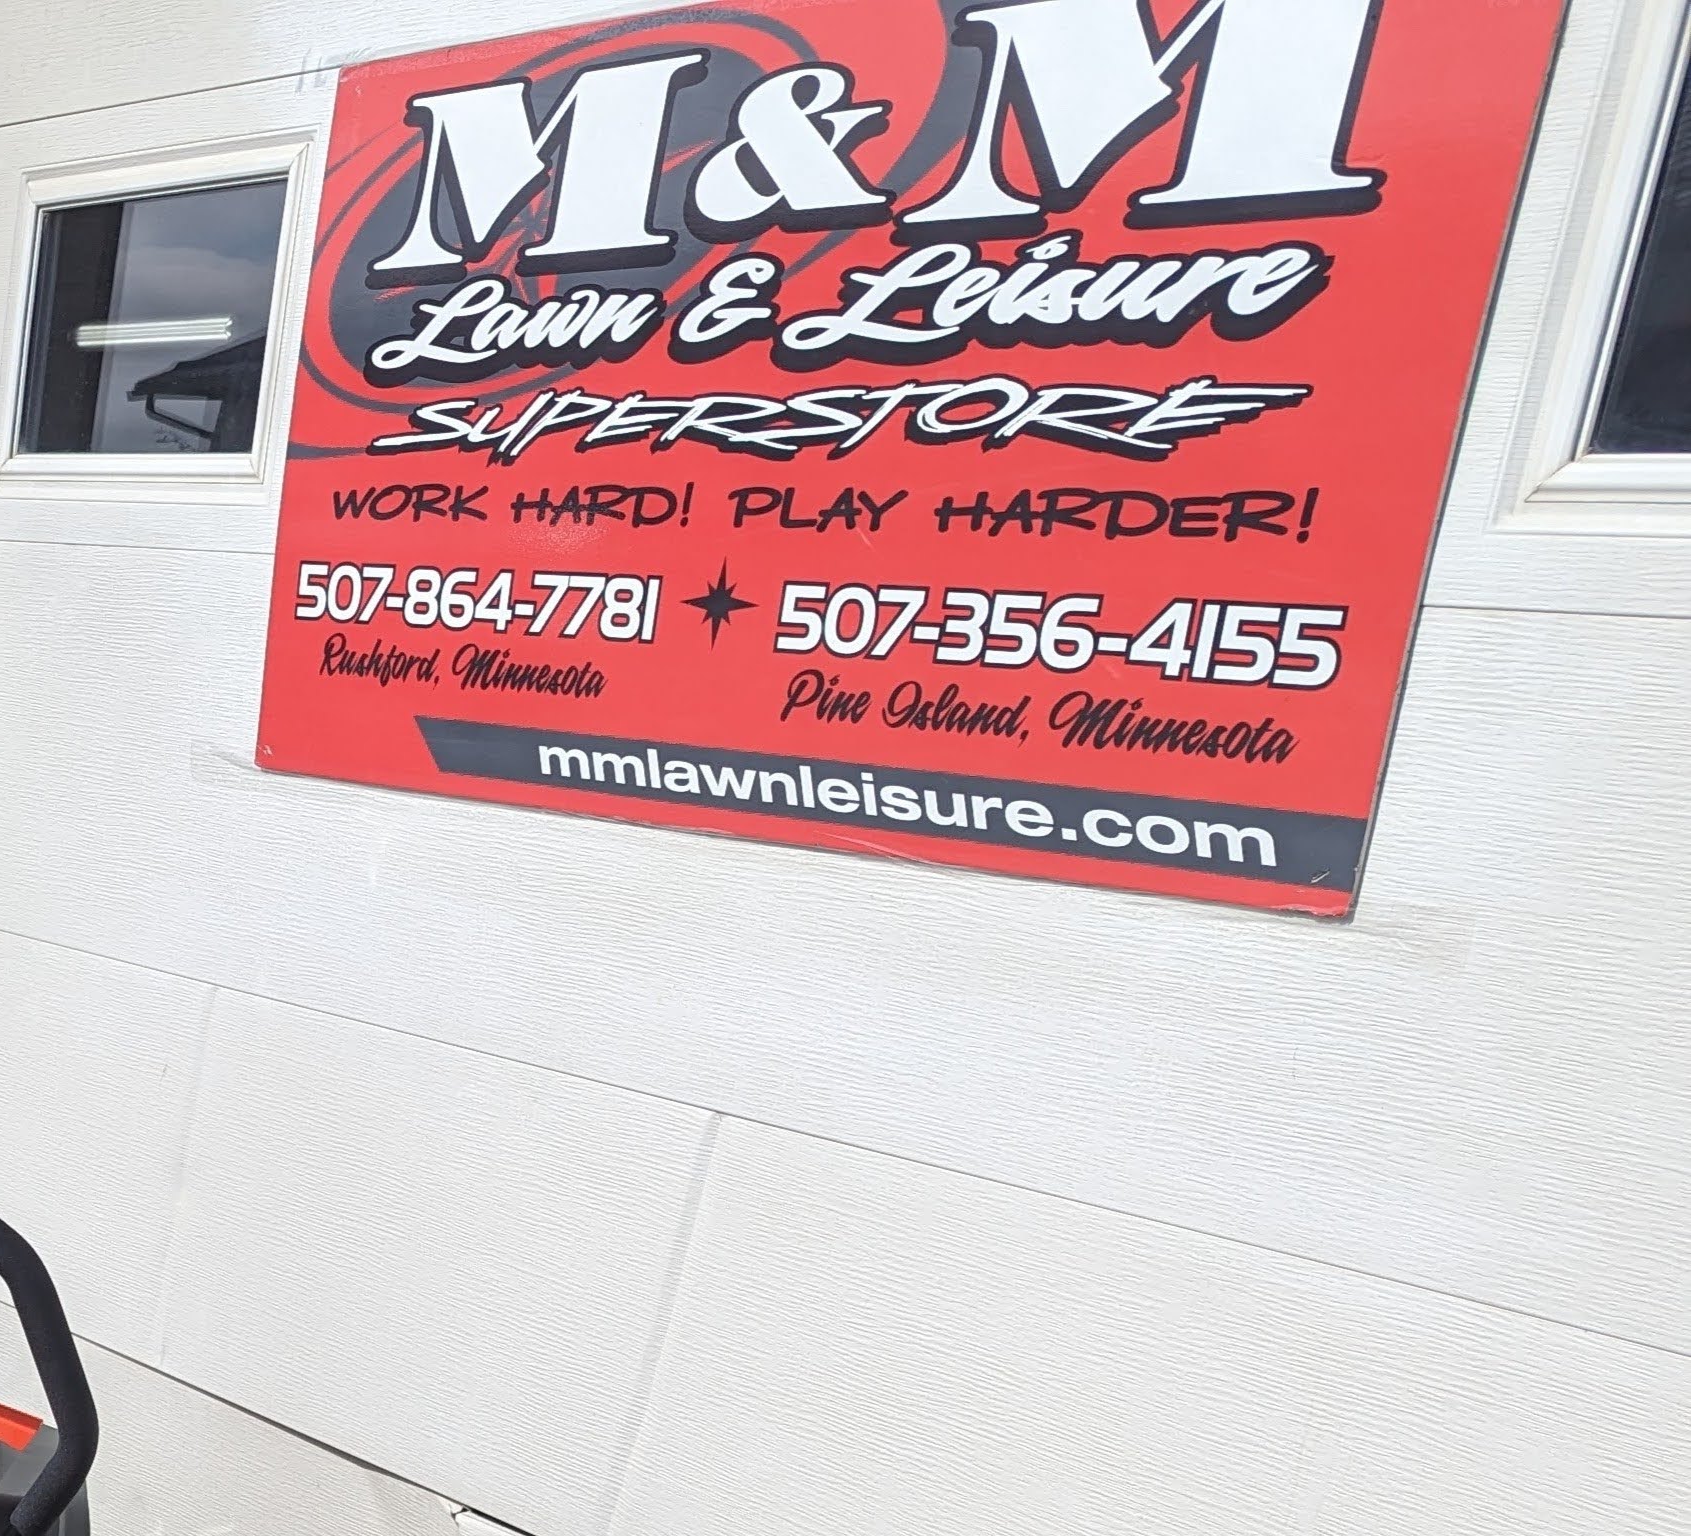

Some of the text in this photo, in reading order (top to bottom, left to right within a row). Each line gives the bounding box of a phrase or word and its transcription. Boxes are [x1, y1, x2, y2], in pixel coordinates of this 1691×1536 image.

[368, 0, 1384, 286] M&M
[368, 232, 1328, 382] Lawn & Leisure
[369, 376, 1312, 465] SUPERSTORE
[332, 482, 1319, 542] WORK HARD! PLAY HARDER!
[295, 561, 1349, 691] 507-864-7781 507-356-4155
[319, 633, 608, 699] Rushford, Minnesota
[781, 670, 1300, 765] Pine Island, Minnesota
[539, 744, 1278, 868] mmlawnleisure.com
